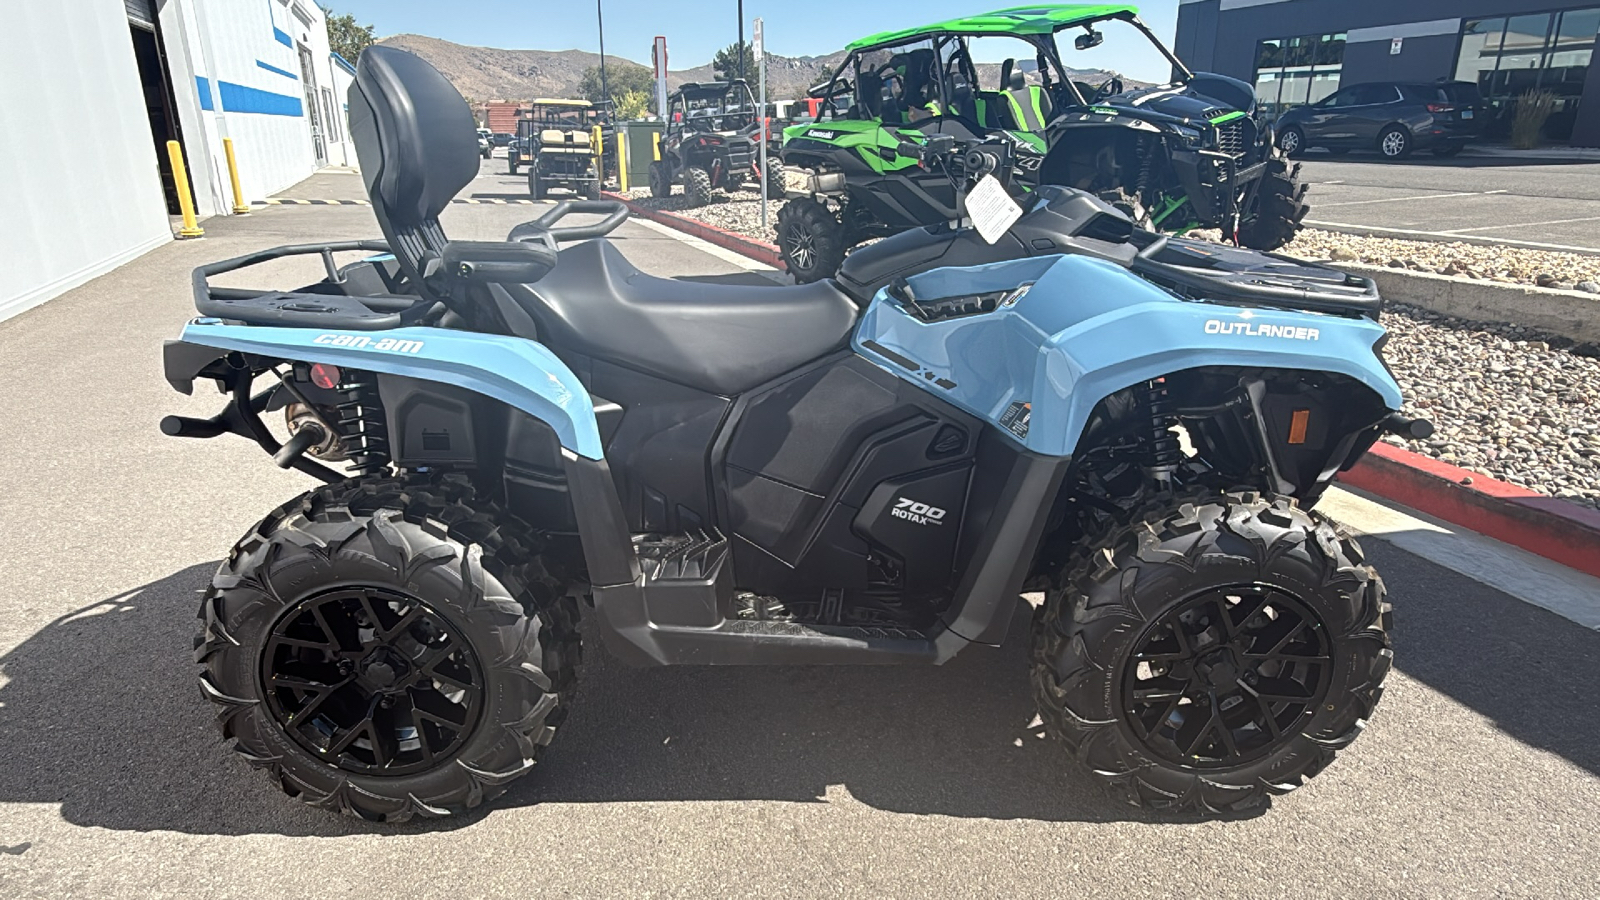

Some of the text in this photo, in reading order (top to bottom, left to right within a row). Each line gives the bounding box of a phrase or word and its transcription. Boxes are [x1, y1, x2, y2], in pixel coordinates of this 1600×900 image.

[1204, 319, 1320, 341] OUTLANDER
[313, 333, 424, 353] can-am
[891, 507, 928, 526] ROTAX
[894, 496, 947, 519] 700
